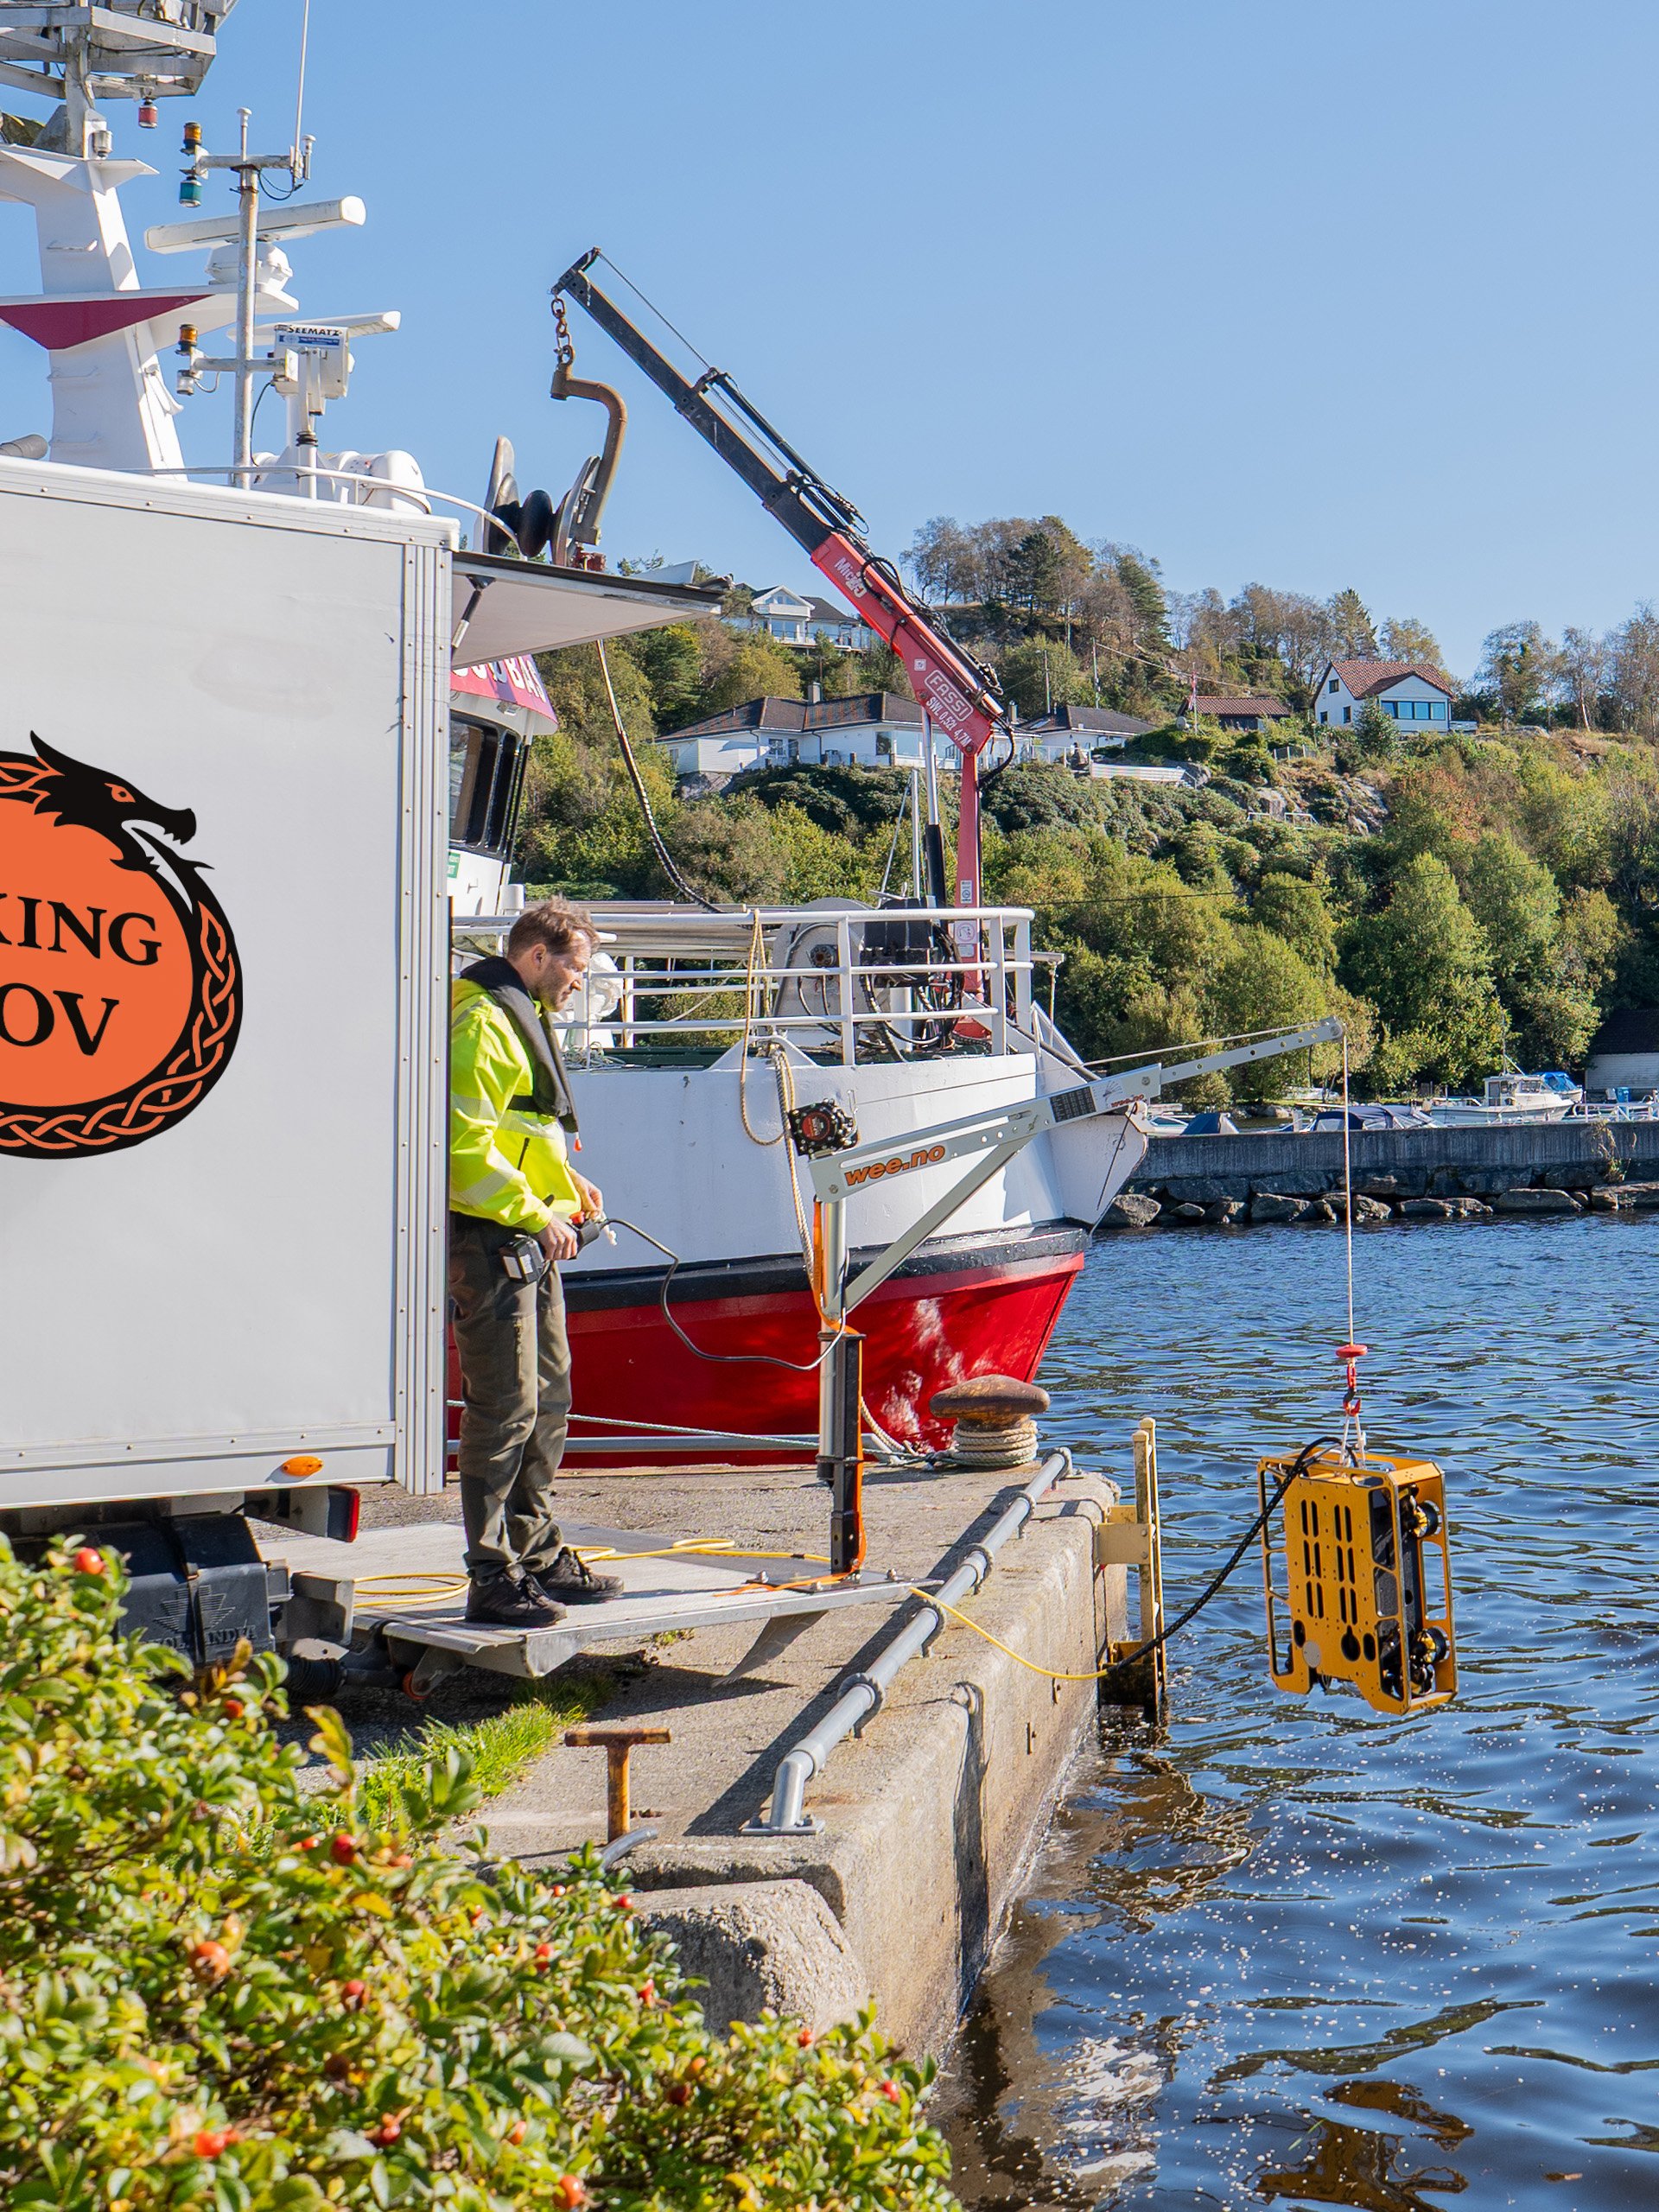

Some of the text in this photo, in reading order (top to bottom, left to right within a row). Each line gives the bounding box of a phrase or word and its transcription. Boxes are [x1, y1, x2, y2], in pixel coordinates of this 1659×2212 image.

[288, 326, 341, 336] SEEMATZ
[930, 675, 969, 716] FASSI
[925, 696, 944, 716] SWL
[954, 728, 973, 747] 4,7M
[844, 1145, 945, 1186] wee.no
